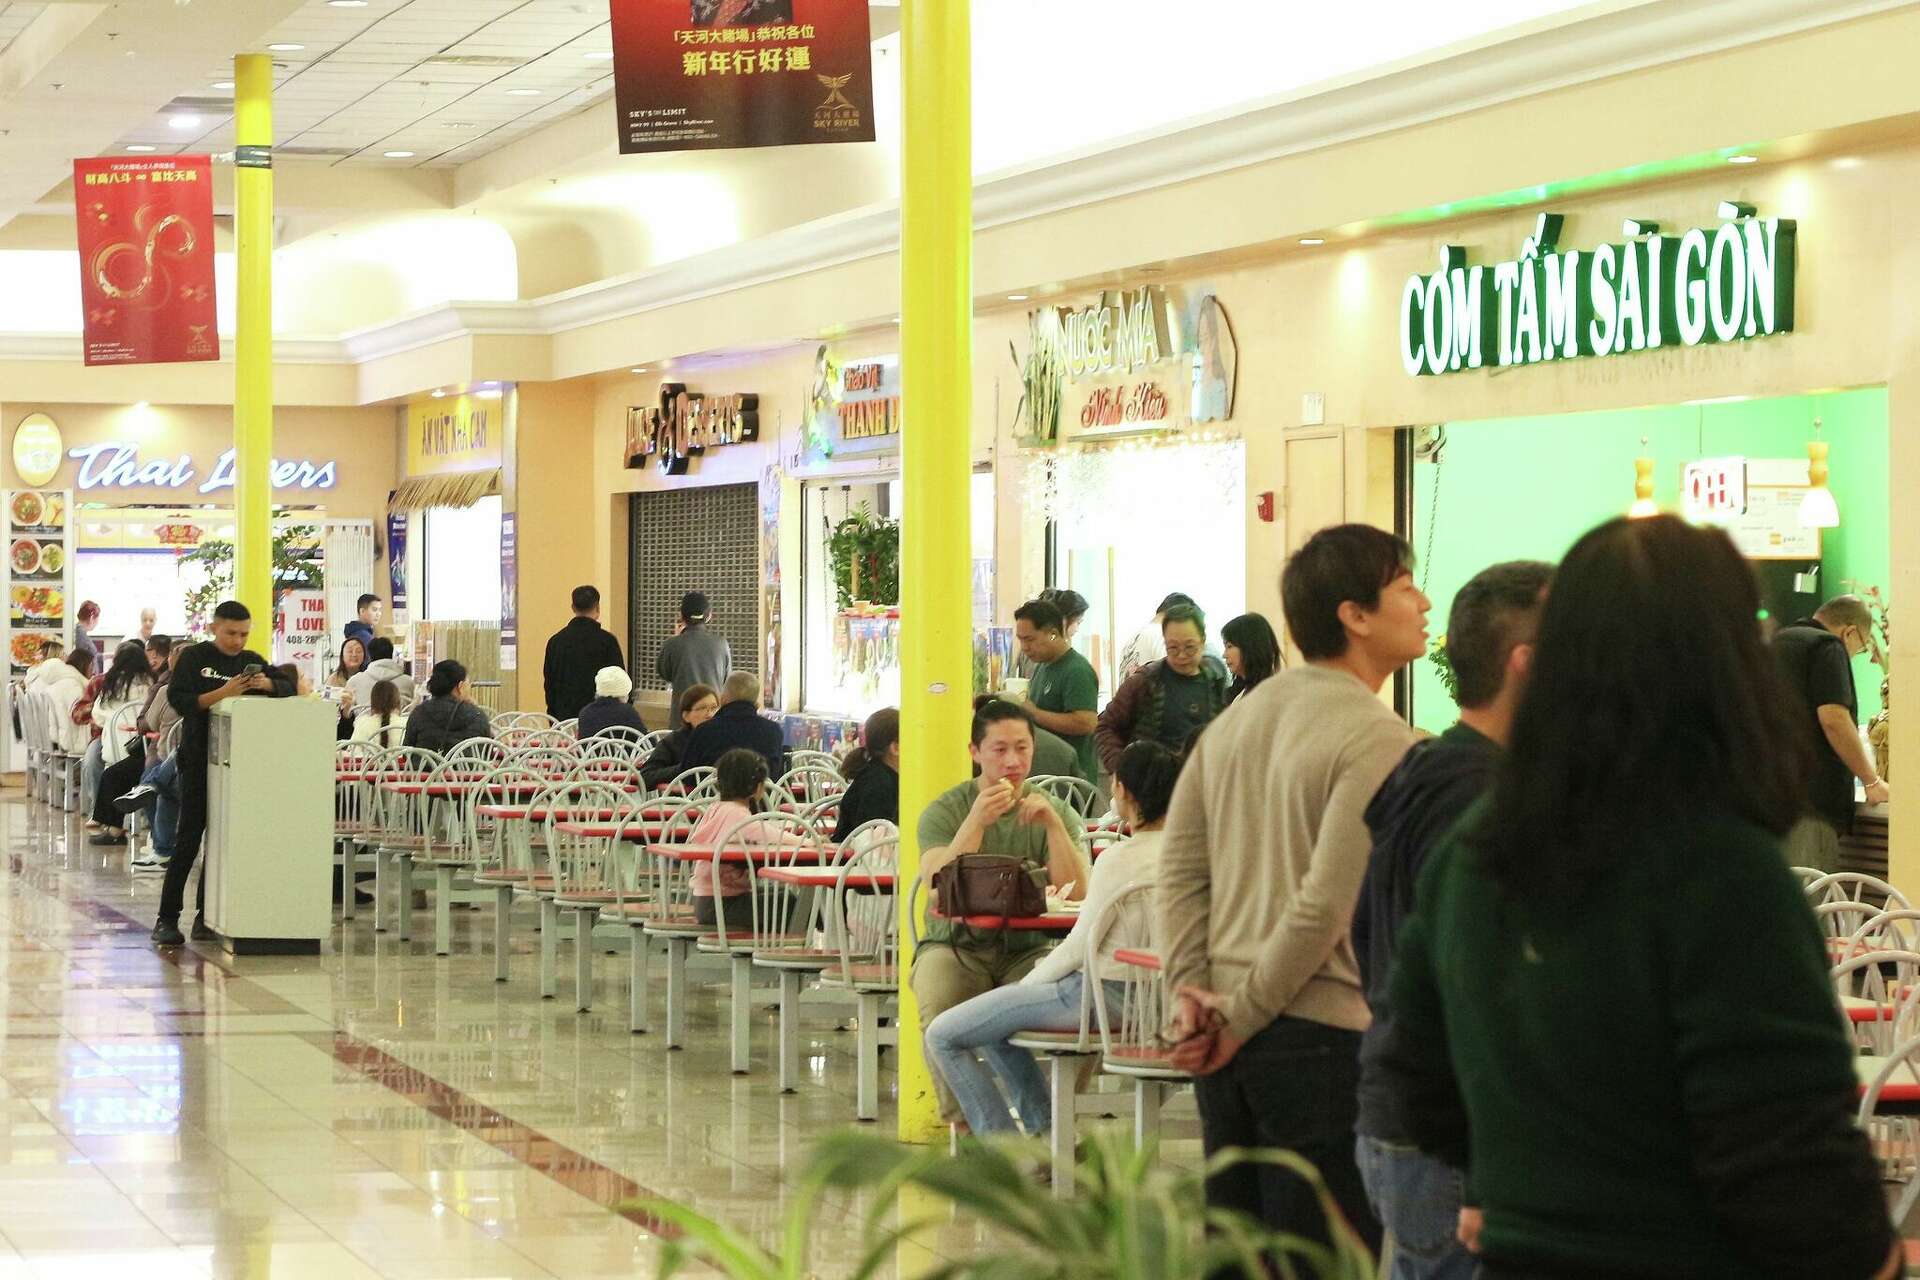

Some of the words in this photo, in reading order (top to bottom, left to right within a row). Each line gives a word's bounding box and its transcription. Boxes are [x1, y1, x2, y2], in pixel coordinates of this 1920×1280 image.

[682, 46, 812, 77] 新年行好運
[814, 119, 832, 128] SKY
[1494, 212, 1580, 367] TẤM
[1589, 218, 1662, 358] SÀI
[1675, 201, 1780, 347] GÒN
[838, 399, 888, 440] THANH
[67, 442, 195, 490] Thai
[199, 447, 337, 494] Lers
[301, 599, 324, 612] THA
[296, 617, 324, 631] LOVE
